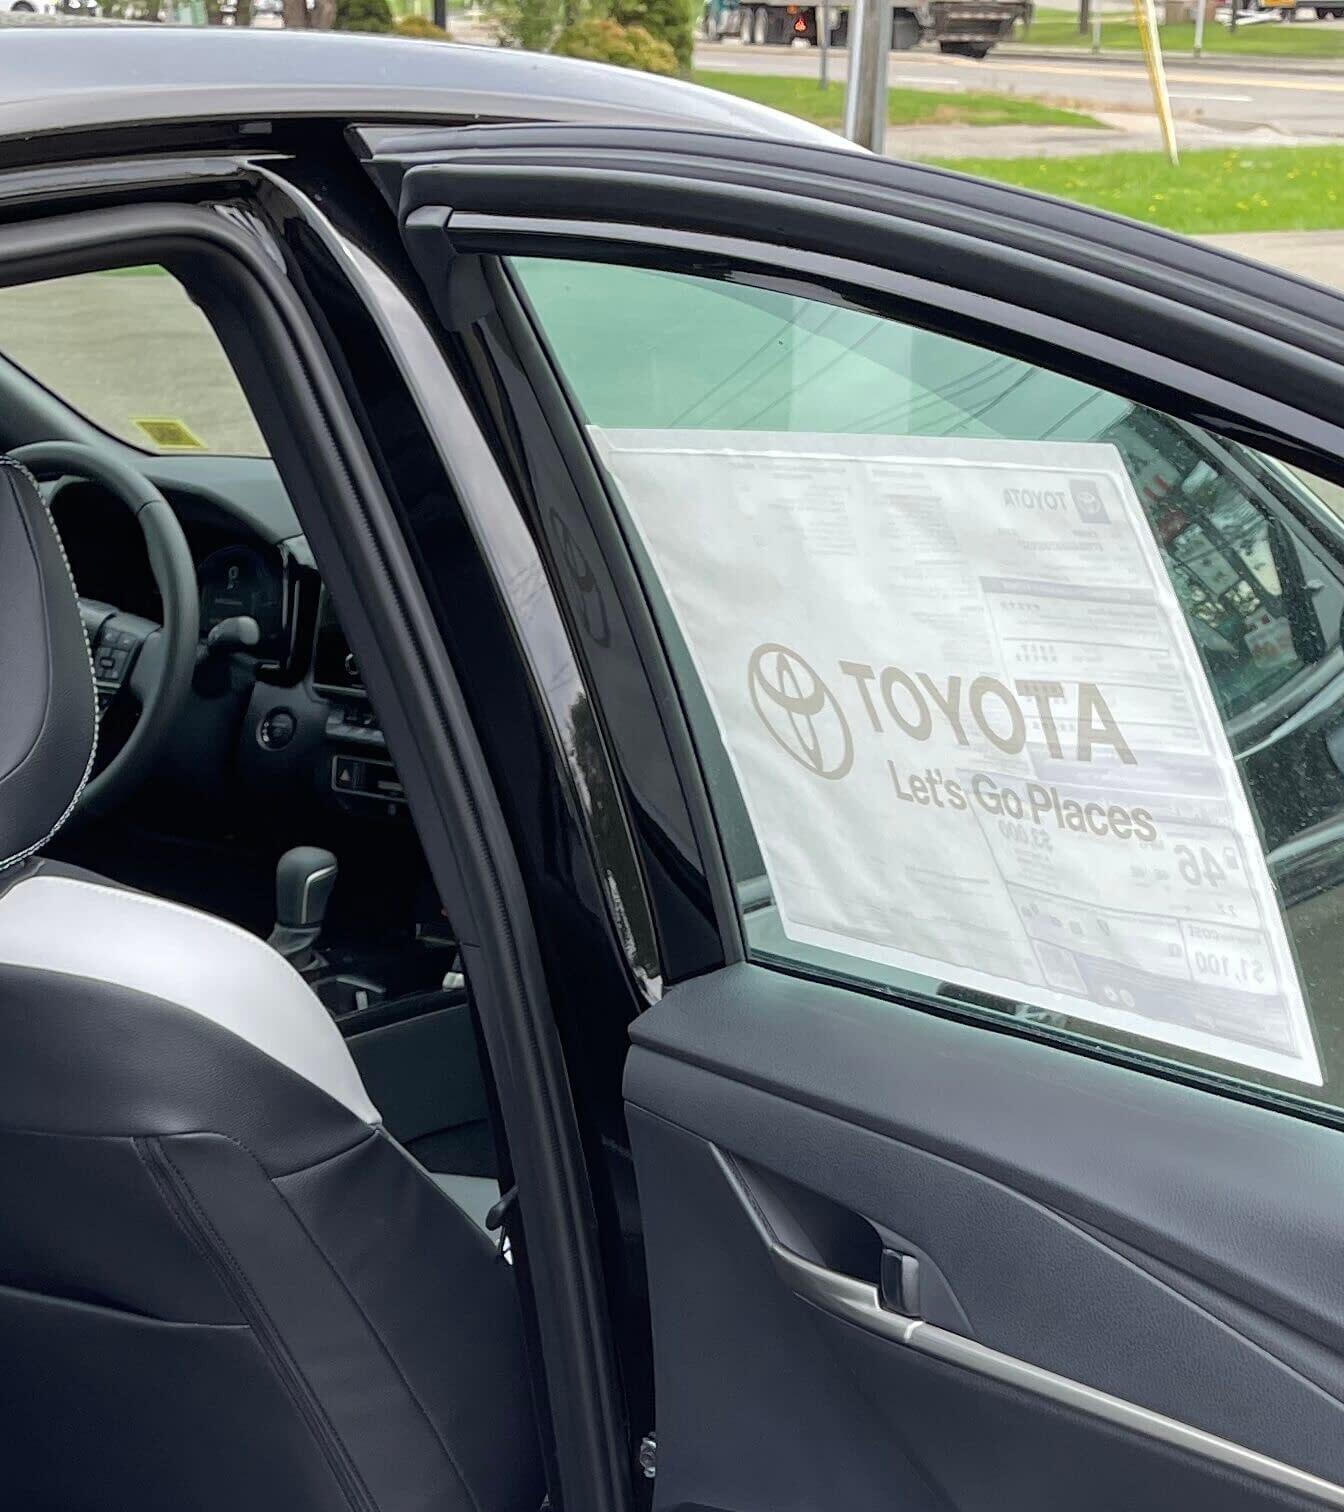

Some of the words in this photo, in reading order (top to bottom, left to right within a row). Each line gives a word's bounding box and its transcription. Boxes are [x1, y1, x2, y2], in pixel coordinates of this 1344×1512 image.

[839, 660, 1139, 766] TOYOTA
[887, 759, 967, 811] Let's
[971, 772, 1025, 820] Go
[1025, 782, 1157, 842] Places
